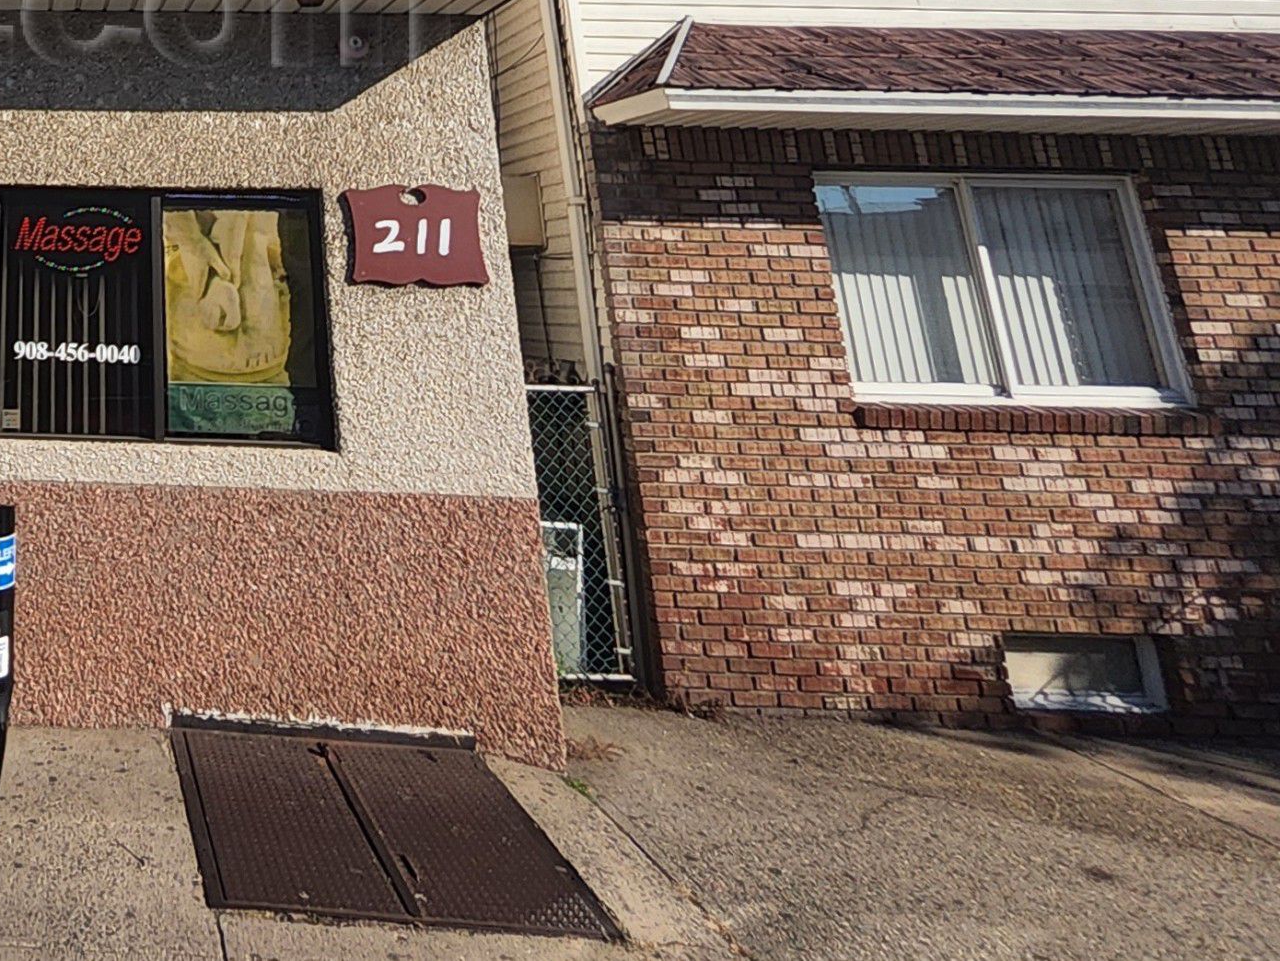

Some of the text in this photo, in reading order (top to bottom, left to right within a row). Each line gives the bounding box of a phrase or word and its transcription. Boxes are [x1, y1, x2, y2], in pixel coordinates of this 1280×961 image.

[15, 217, 141, 261] Massage
[372, 218, 451, 256] 211
[13, 341, 141, 364] 908-456-0040
